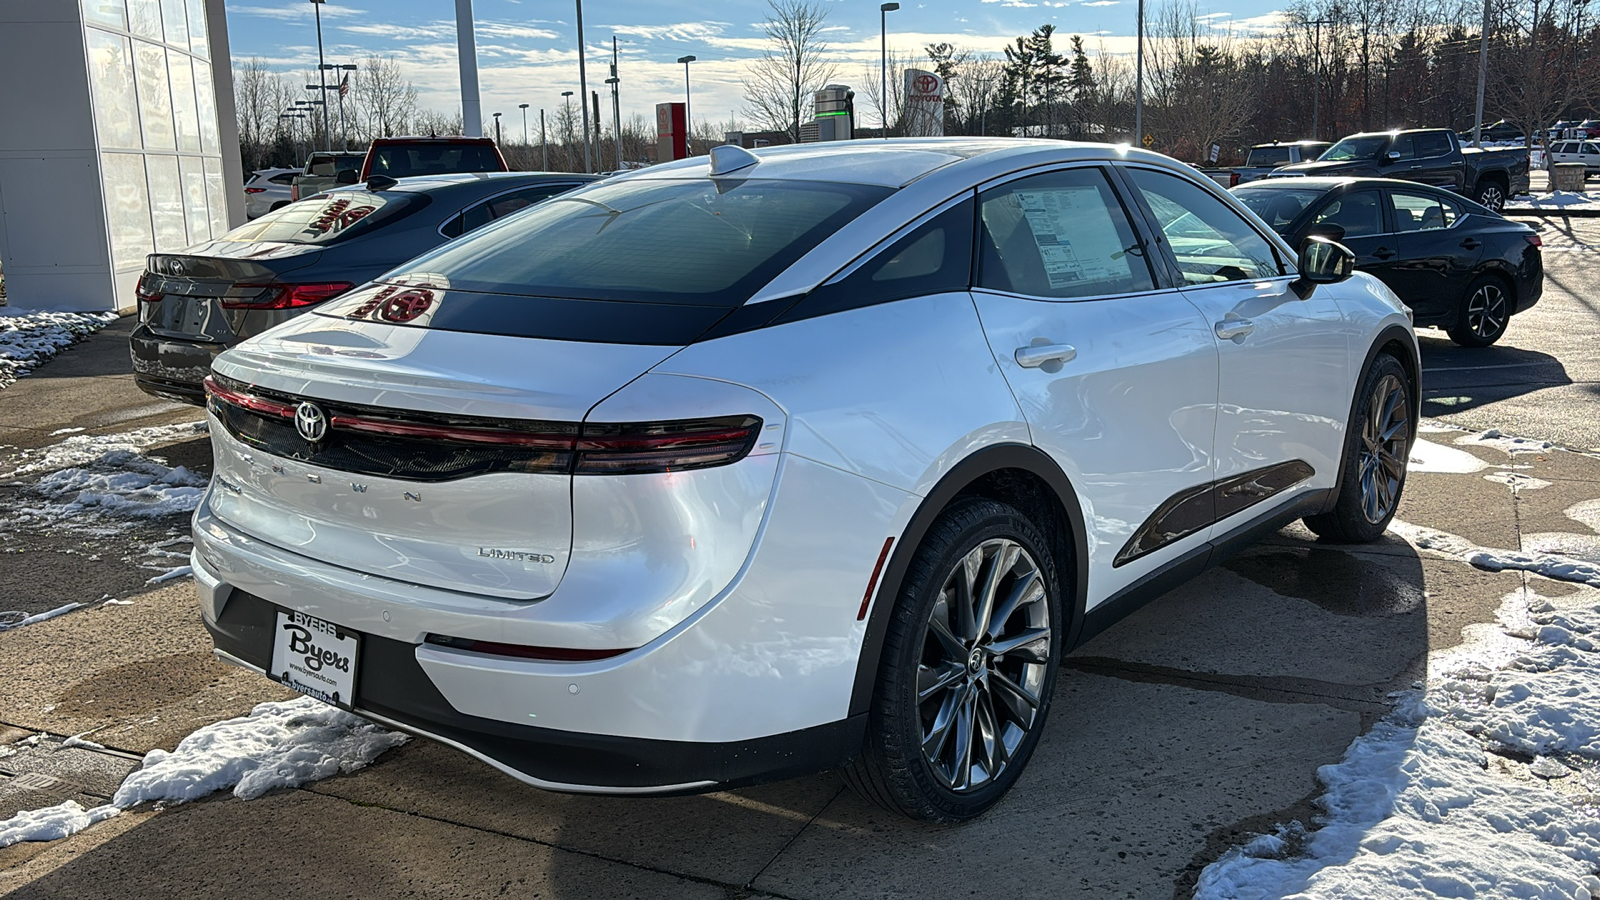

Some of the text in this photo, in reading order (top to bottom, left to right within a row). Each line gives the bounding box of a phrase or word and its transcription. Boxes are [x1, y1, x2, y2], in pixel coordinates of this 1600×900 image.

[477, 547, 555, 564] LIMITED
[294, 611, 337, 638] BYERS
[283, 624, 349, 672] Byers
[289, 662, 338, 687] www.byersauto.com
[16, 774, 78, 794] ELECTRIC
